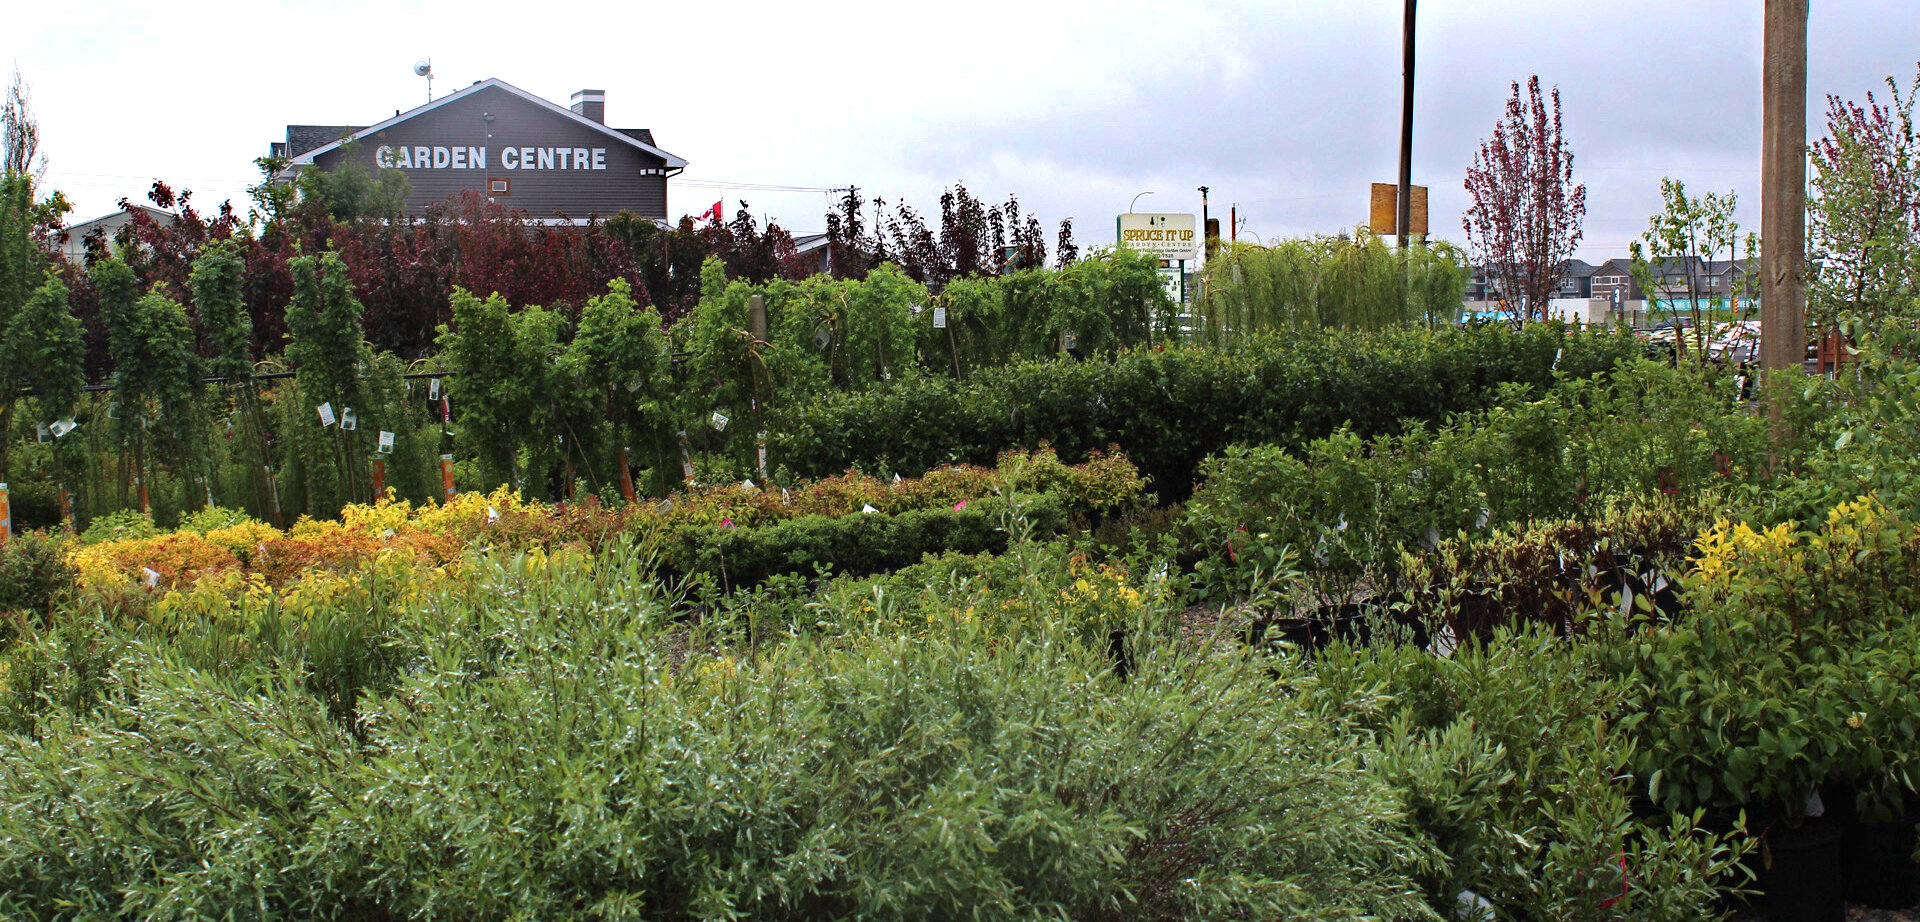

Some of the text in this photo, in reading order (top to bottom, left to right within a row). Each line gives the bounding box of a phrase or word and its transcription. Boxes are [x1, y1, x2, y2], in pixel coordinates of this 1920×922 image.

[376, 146, 607, 170] GARDEN CENTRE
[1123, 229, 1194, 241] SPRUCE IT UP
[1614, 288, 1620, 303] 3
